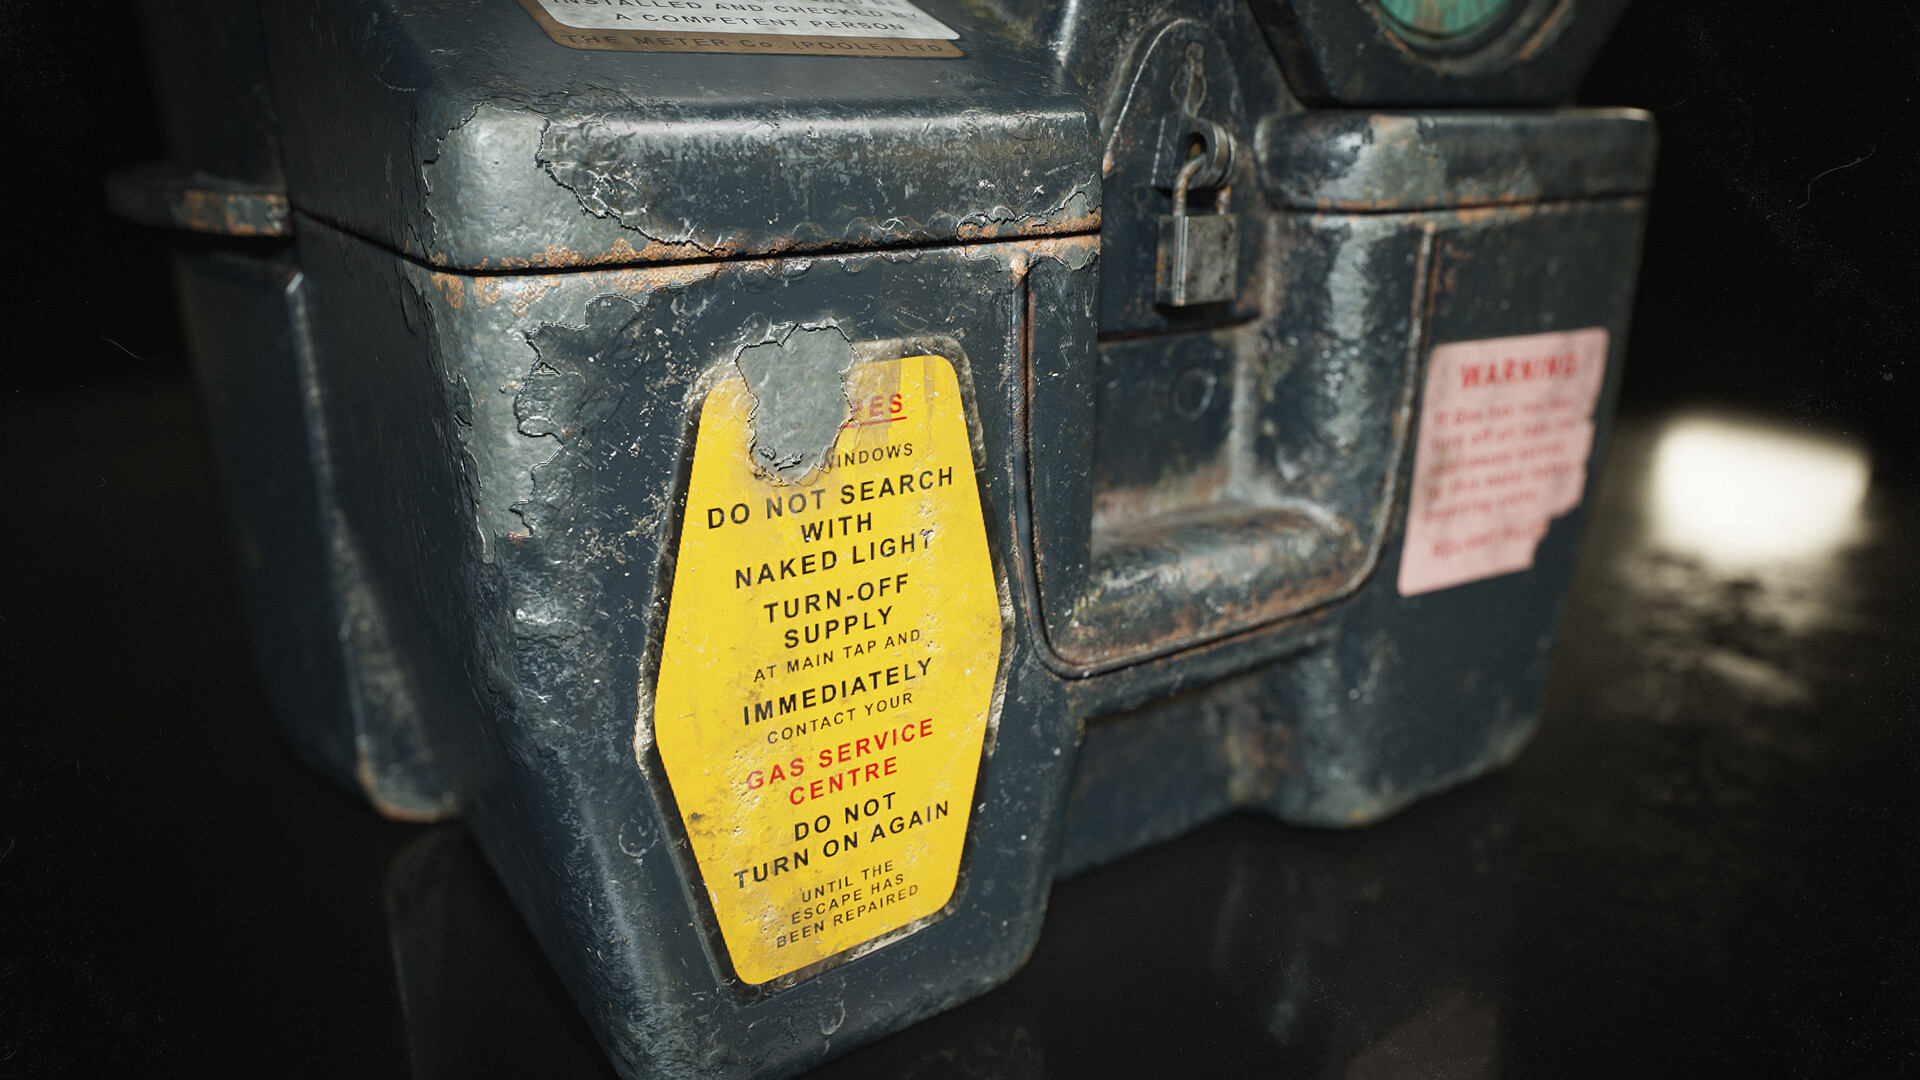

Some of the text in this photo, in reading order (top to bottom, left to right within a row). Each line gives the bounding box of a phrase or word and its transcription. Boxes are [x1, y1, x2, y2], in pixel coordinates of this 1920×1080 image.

[615, 13, 906, 31] A COMPETENT PERSON
[715, 3, 764, 13] AND
[773, 6, 884, 17] CHECKED
[560, 34, 953, 53] THE METER Co. (POOLE) LTD.
[1461, 351, 1577, 389] WARNING
[821, 442, 914, 471] WINDOWS
[708, 466, 953, 530] DO NOT SEARCH
[801, 512, 872, 543] WITH
[735, 529, 934, 589] NAKED LIGHT
[763, 573, 910, 623] TURN-OFF
[785, 606, 893, 649] SUPPLY
[754, 628, 921, 683] AT MAIN TAP AND
[743, 657, 933, 726] IMMEDIATELY
[767, 692, 913, 744] CONTACT YOUR
[746, 718, 933, 791] GAS SERVICE
[789, 756, 898, 806] CENTRE
[794, 792, 897, 841] DO NOT
[734, 801, 948, 890] TURN ON AGAIN
[792, 874, 904, 924] ESCAPE HAS
[802, 860, 893, 903] UNTIL THE
[776, 884, 919, 948] BEEN REPAIRED
